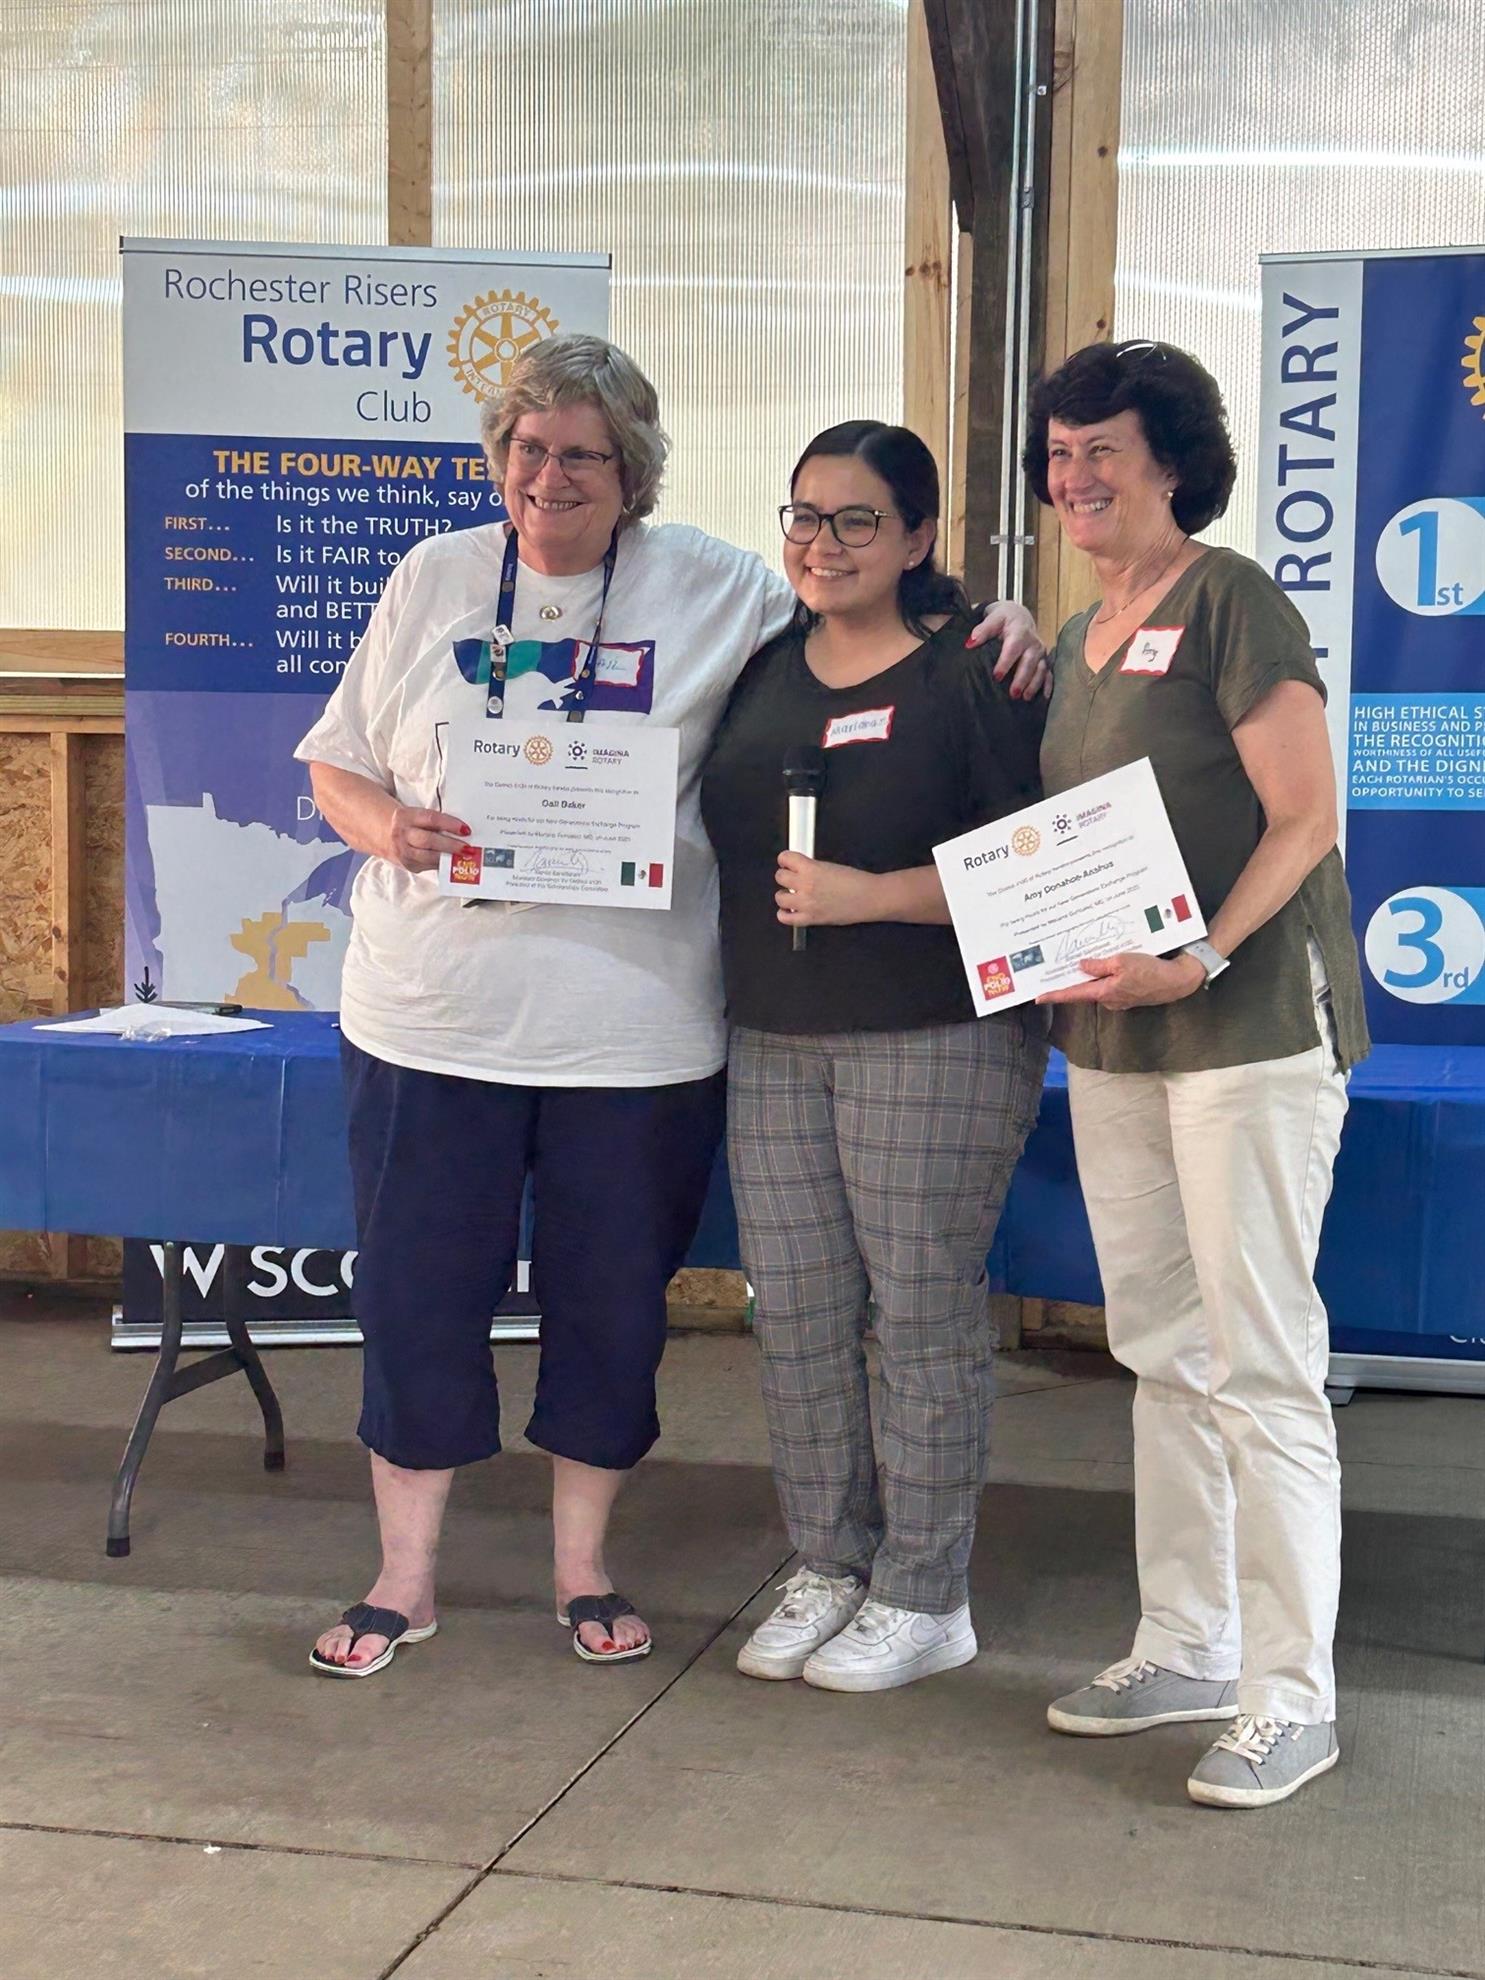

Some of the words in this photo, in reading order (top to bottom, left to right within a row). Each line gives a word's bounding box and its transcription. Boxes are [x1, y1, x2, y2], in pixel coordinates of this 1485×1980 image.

[164, 268, 331, 304] Rochester
[344, 275, 438, 308] Risers
[243, 313, 433, 380] Rotary
[356, 391, 432, 424] Club
[1274, 292, 1340, 591] ROTARY
[213, 450, 270, 475] THE
[280, 452, 442, 480] FOUR-WAY
[451, 457, 486, 480] TE
[185, 479, 210, 498] of
[216, 480, 254, 500] the
[260, 482, 331, 507] things
[336, 487, 370, 503] we
[377, 484, 440, 508] think,
[448, 490, 482, 511] say
[489, 492, 503, 507] o
[165, 517, 230, 531] FIRST...
[277, 515, 292, 534] Is
[299, 515, 315, 535] it
[321, 516, 358, 535] the
[365, 517, 453, 537] TRUTH?
[164, 547, 254, 563] SECOND...
[277, 546, 293, 565] Is
[299, 546, 315, 566] it
[323, 547, 370, 566] FAIR
[377, 548, 401, 566] to
[1399, 511, 1464, 606] 1st
[164, 577, 237, 592] THIRD...
[276, 575, 319, 594] Will
[327, 576, 342, 595] it
[276, 600, 317, 619] and
[326, 602, 378, 620] BETT
[165, 632, 253, 648] FOURTH...
[276, 630, 319, 649] Will
[327, 631, 342, 650] it
[350, 631, 362, 649] b
[276, 655, 301, 673] all
[309, 658, 347, 674] con
[1354, 706, 1395, 720] HIGH
[1400, 706, 1469, 720] ETHICAL
[1354, 721, 1368, 732] IN
[1372, 721, 1437, 732] BUSINESS
[1440, 721, 1471, 732] AND
[474, 740, 521, 757] Rotary
[1353, 734, 1385, 748] THE
[1353, 748, 1417, 757] WORTHINESS
[1420, 748, 1432, 757] OF
[1435, 748, 1455, 757] ALL
[1352, 760, 1392, 773] AND
[1396, 760, 1430, 773] THE
[1352, 775, 1382, 784] EACH
[1386, 775, 1454, 784] ROTARIAN'S
[1352, 787, 1445, 798] OPPORTUNITY
[1447, 788, 1464, 798] TO
[964, 845, 1010, 872] Rotary
[1384, 896, 1470, 988] 3rd
